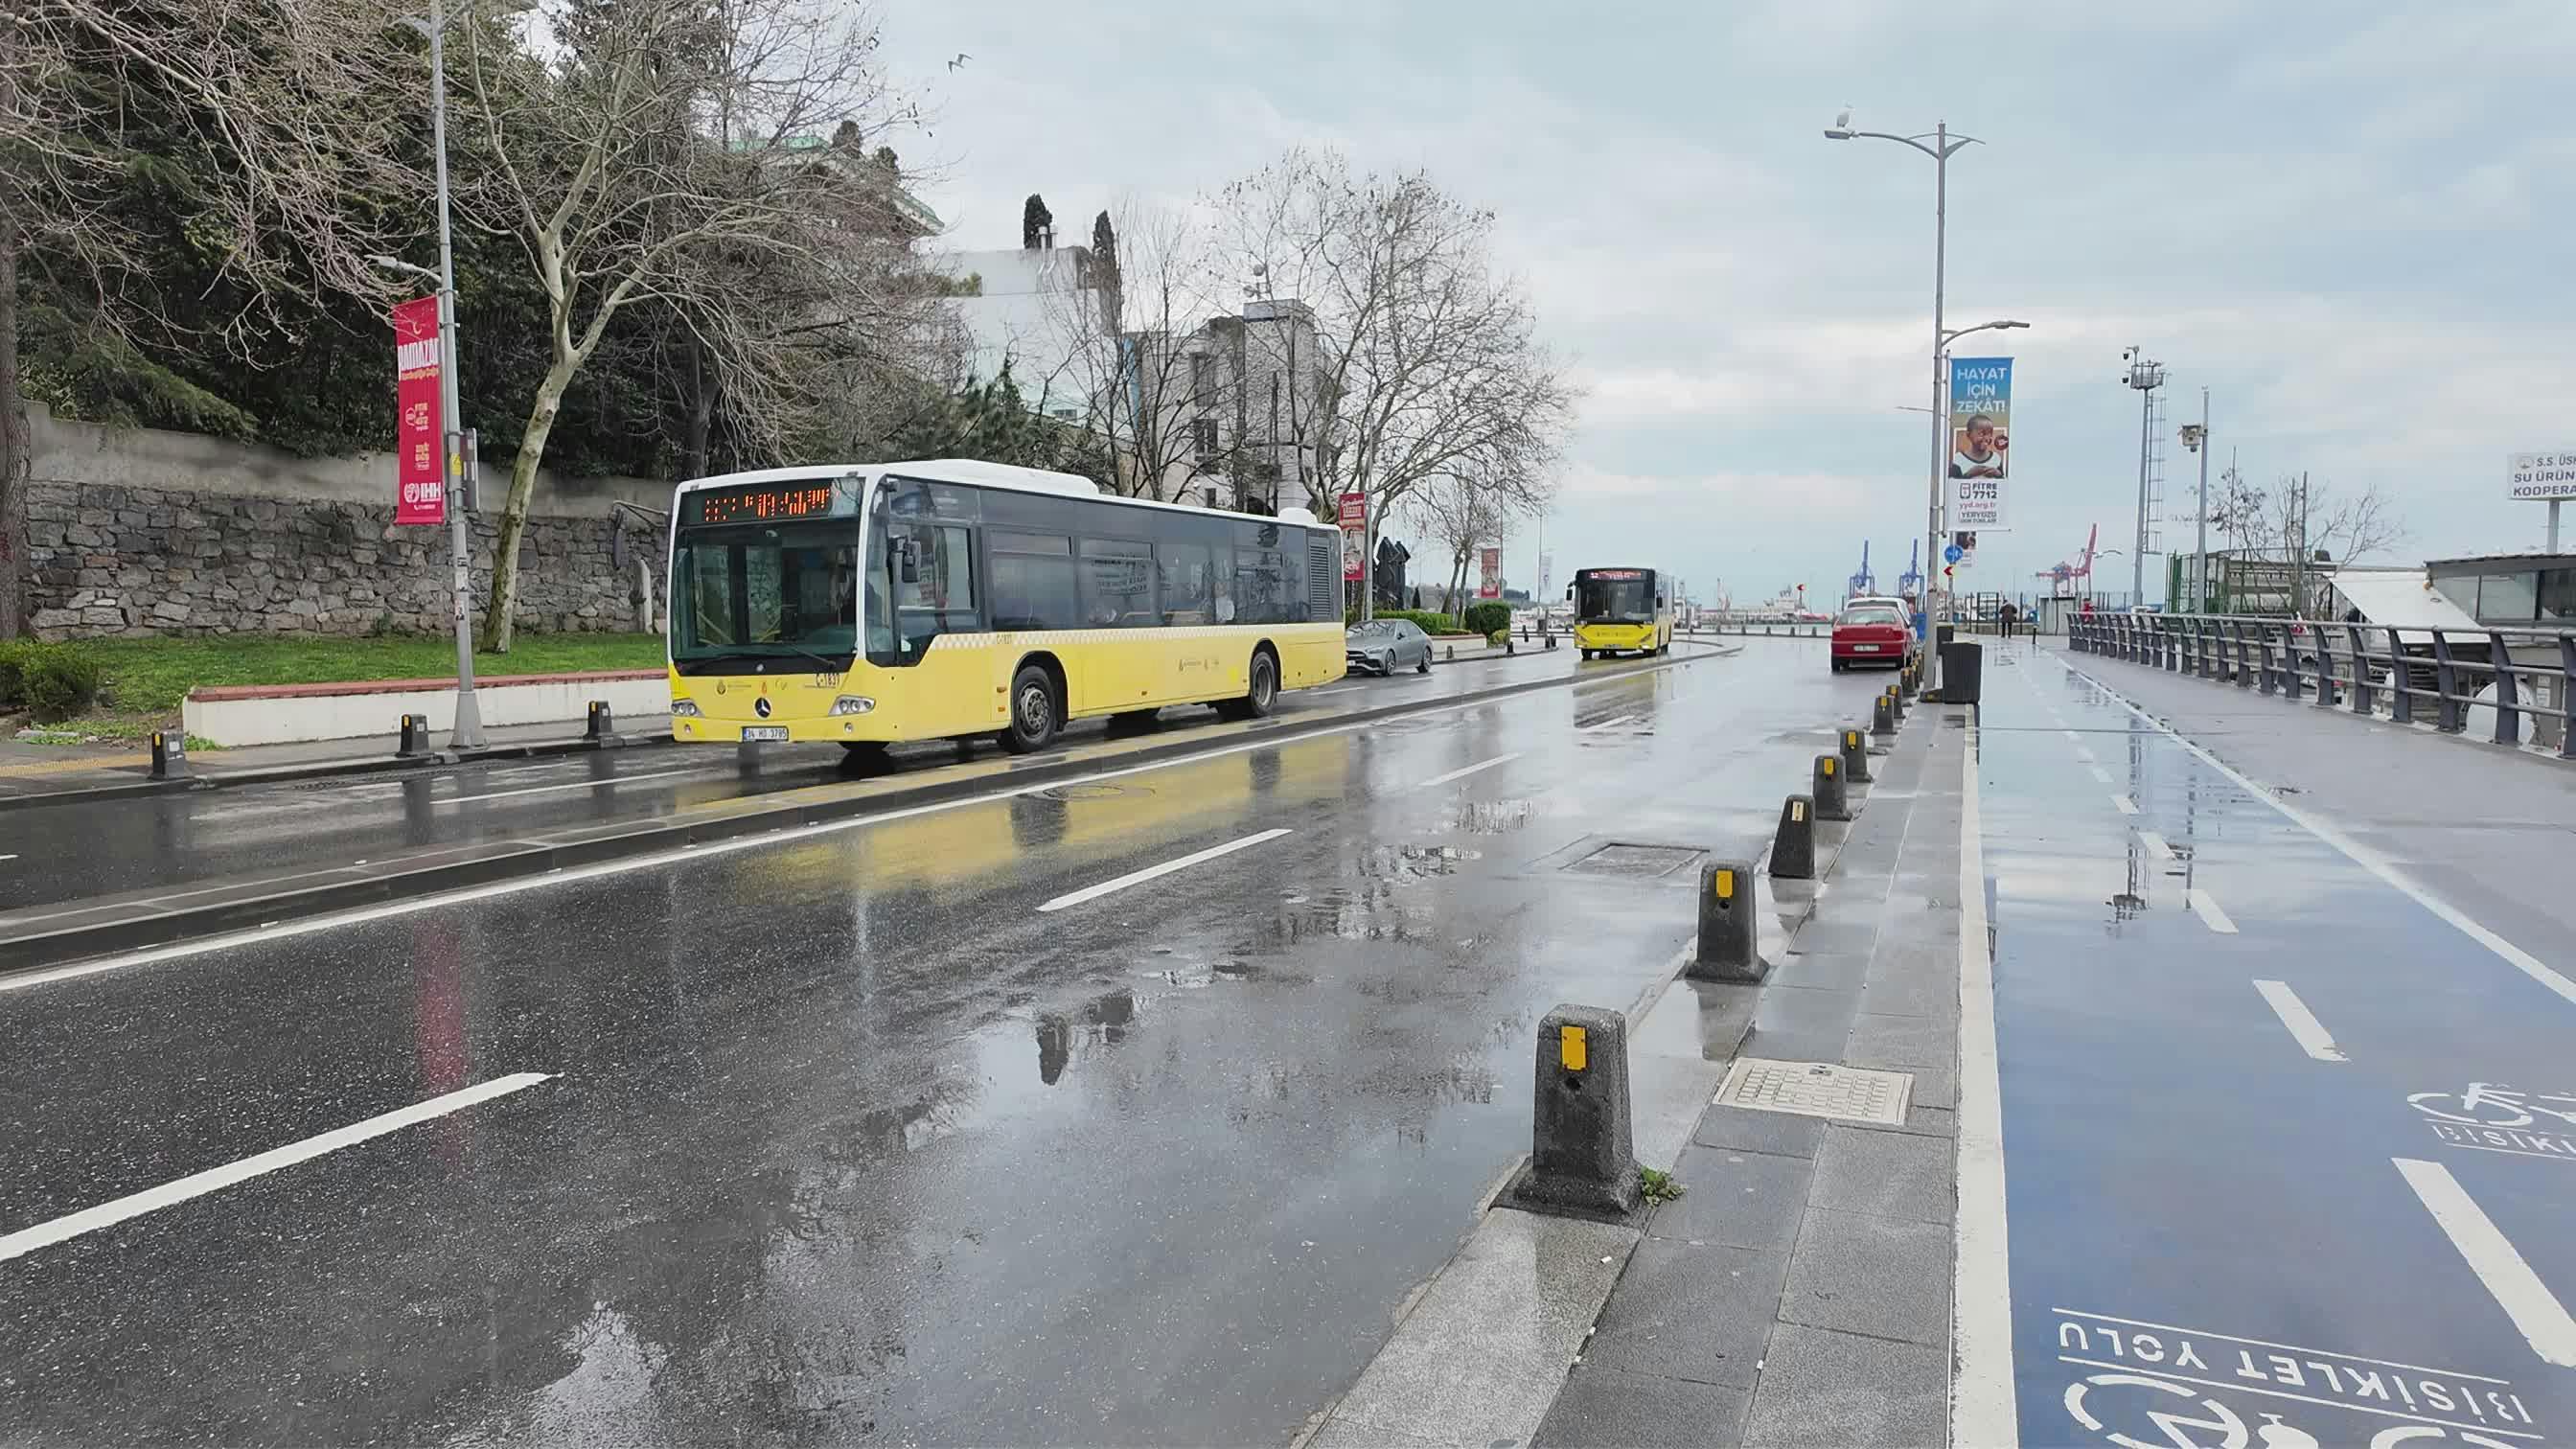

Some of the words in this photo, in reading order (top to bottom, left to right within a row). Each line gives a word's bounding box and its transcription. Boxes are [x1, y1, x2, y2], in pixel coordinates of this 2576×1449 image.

[1957, 368, 2007, 380] HAYAT
[1967, 381, 1995, 399] İÇİN
[2515, 473, 2532, 483] SU
[1972, 491, 1997, 499] 7712
[2059, 1322, 2209, 1371] YOLU
[2236, 1349, 2533, 1424] BİSİKLET
